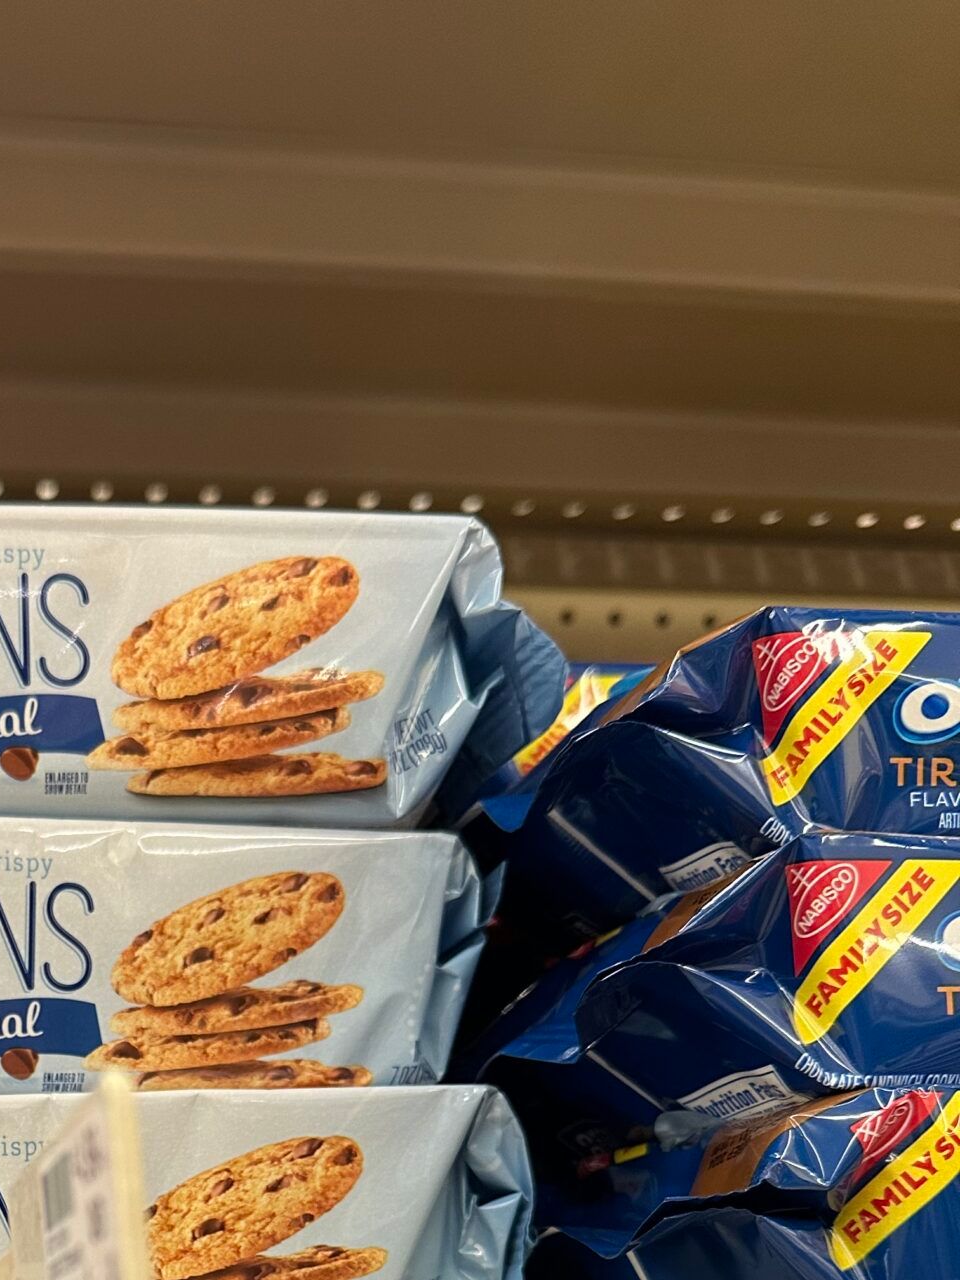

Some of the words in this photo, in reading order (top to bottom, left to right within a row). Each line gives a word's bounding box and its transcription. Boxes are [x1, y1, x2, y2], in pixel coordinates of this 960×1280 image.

[767, 640, 818, 704] NABISCO
[770, 687, 852, 788] FAMILY
[847, 638, 898, 698] SIZE
[798, 868, 854, 933] NABISCO
[805, 919, 887, 1019] FAMILY
[881, 866, 936, 927] SIZE
[842, 1151, 939, 1245] FAMILY
